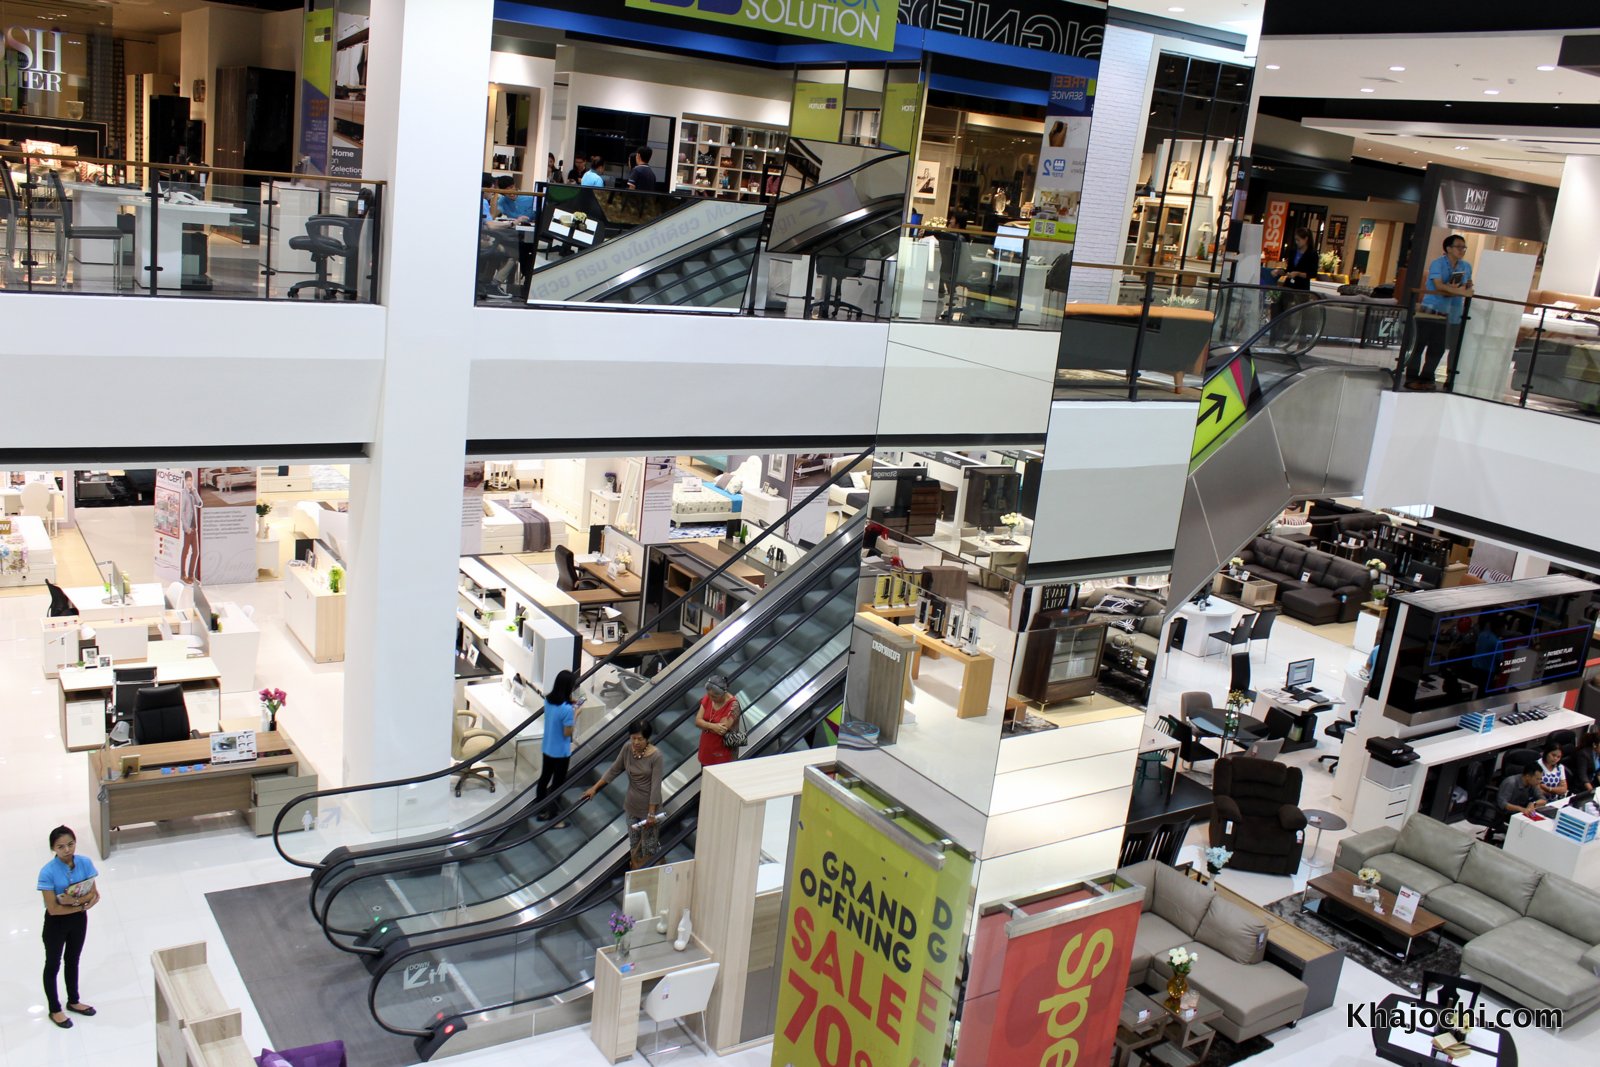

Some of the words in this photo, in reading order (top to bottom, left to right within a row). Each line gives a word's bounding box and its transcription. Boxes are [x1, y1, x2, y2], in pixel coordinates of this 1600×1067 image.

[745, 0, 880, 41] SOLUTION
[0, 27, 67, 75] SH
[331, 148, 354, 158] Home
[1446, 213, 1484, 227] CUSTOMIZED
[1483, 218, 1497, 229] BED
[1465, 188, 1489, 206] POSH
[1263, 201, 1286, 249] Best
[822, 850, 917, 941] GRAND
[799, 867, 912, 974] OPENING
[410, 961, 430, 970] DOWN
[791, 906, 907, 1046] SALE
[783, 968, 873, 1067] 70
